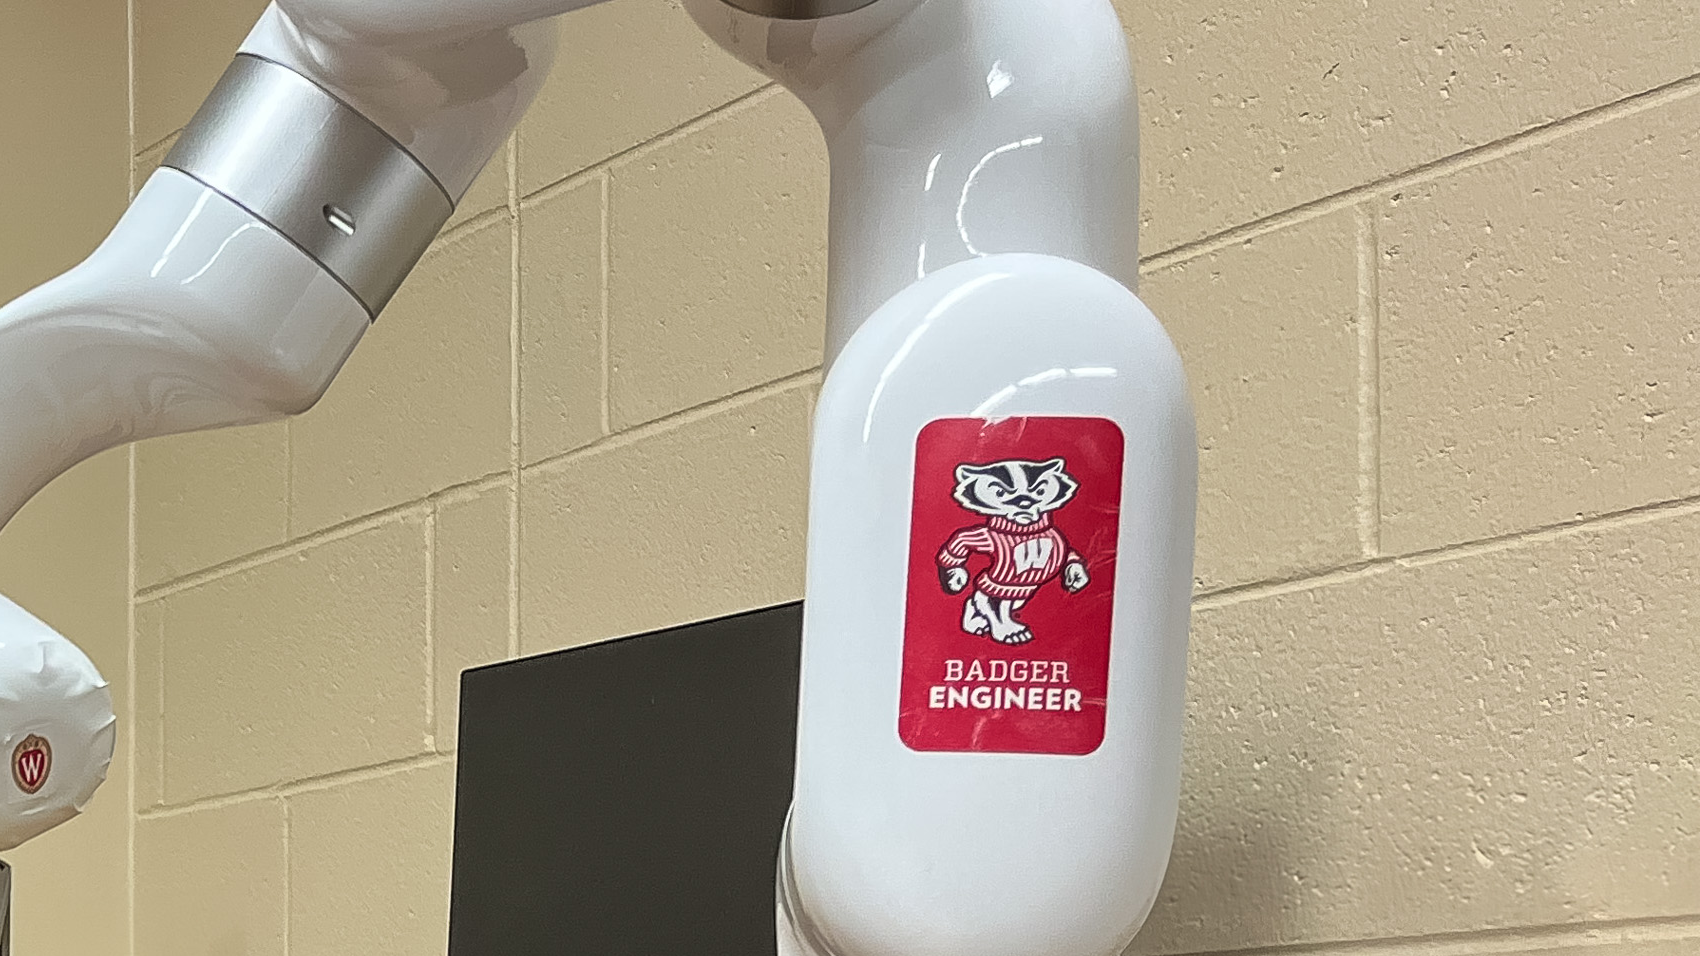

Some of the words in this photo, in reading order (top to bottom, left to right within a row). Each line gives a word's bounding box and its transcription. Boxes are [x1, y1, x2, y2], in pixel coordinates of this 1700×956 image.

[1013, 537, 1054, 575] W
[943, 659, 1070, 683] BADGER
[928, 685, 1082, 712] ENGINEER
[21, 752, 43, 783] W
